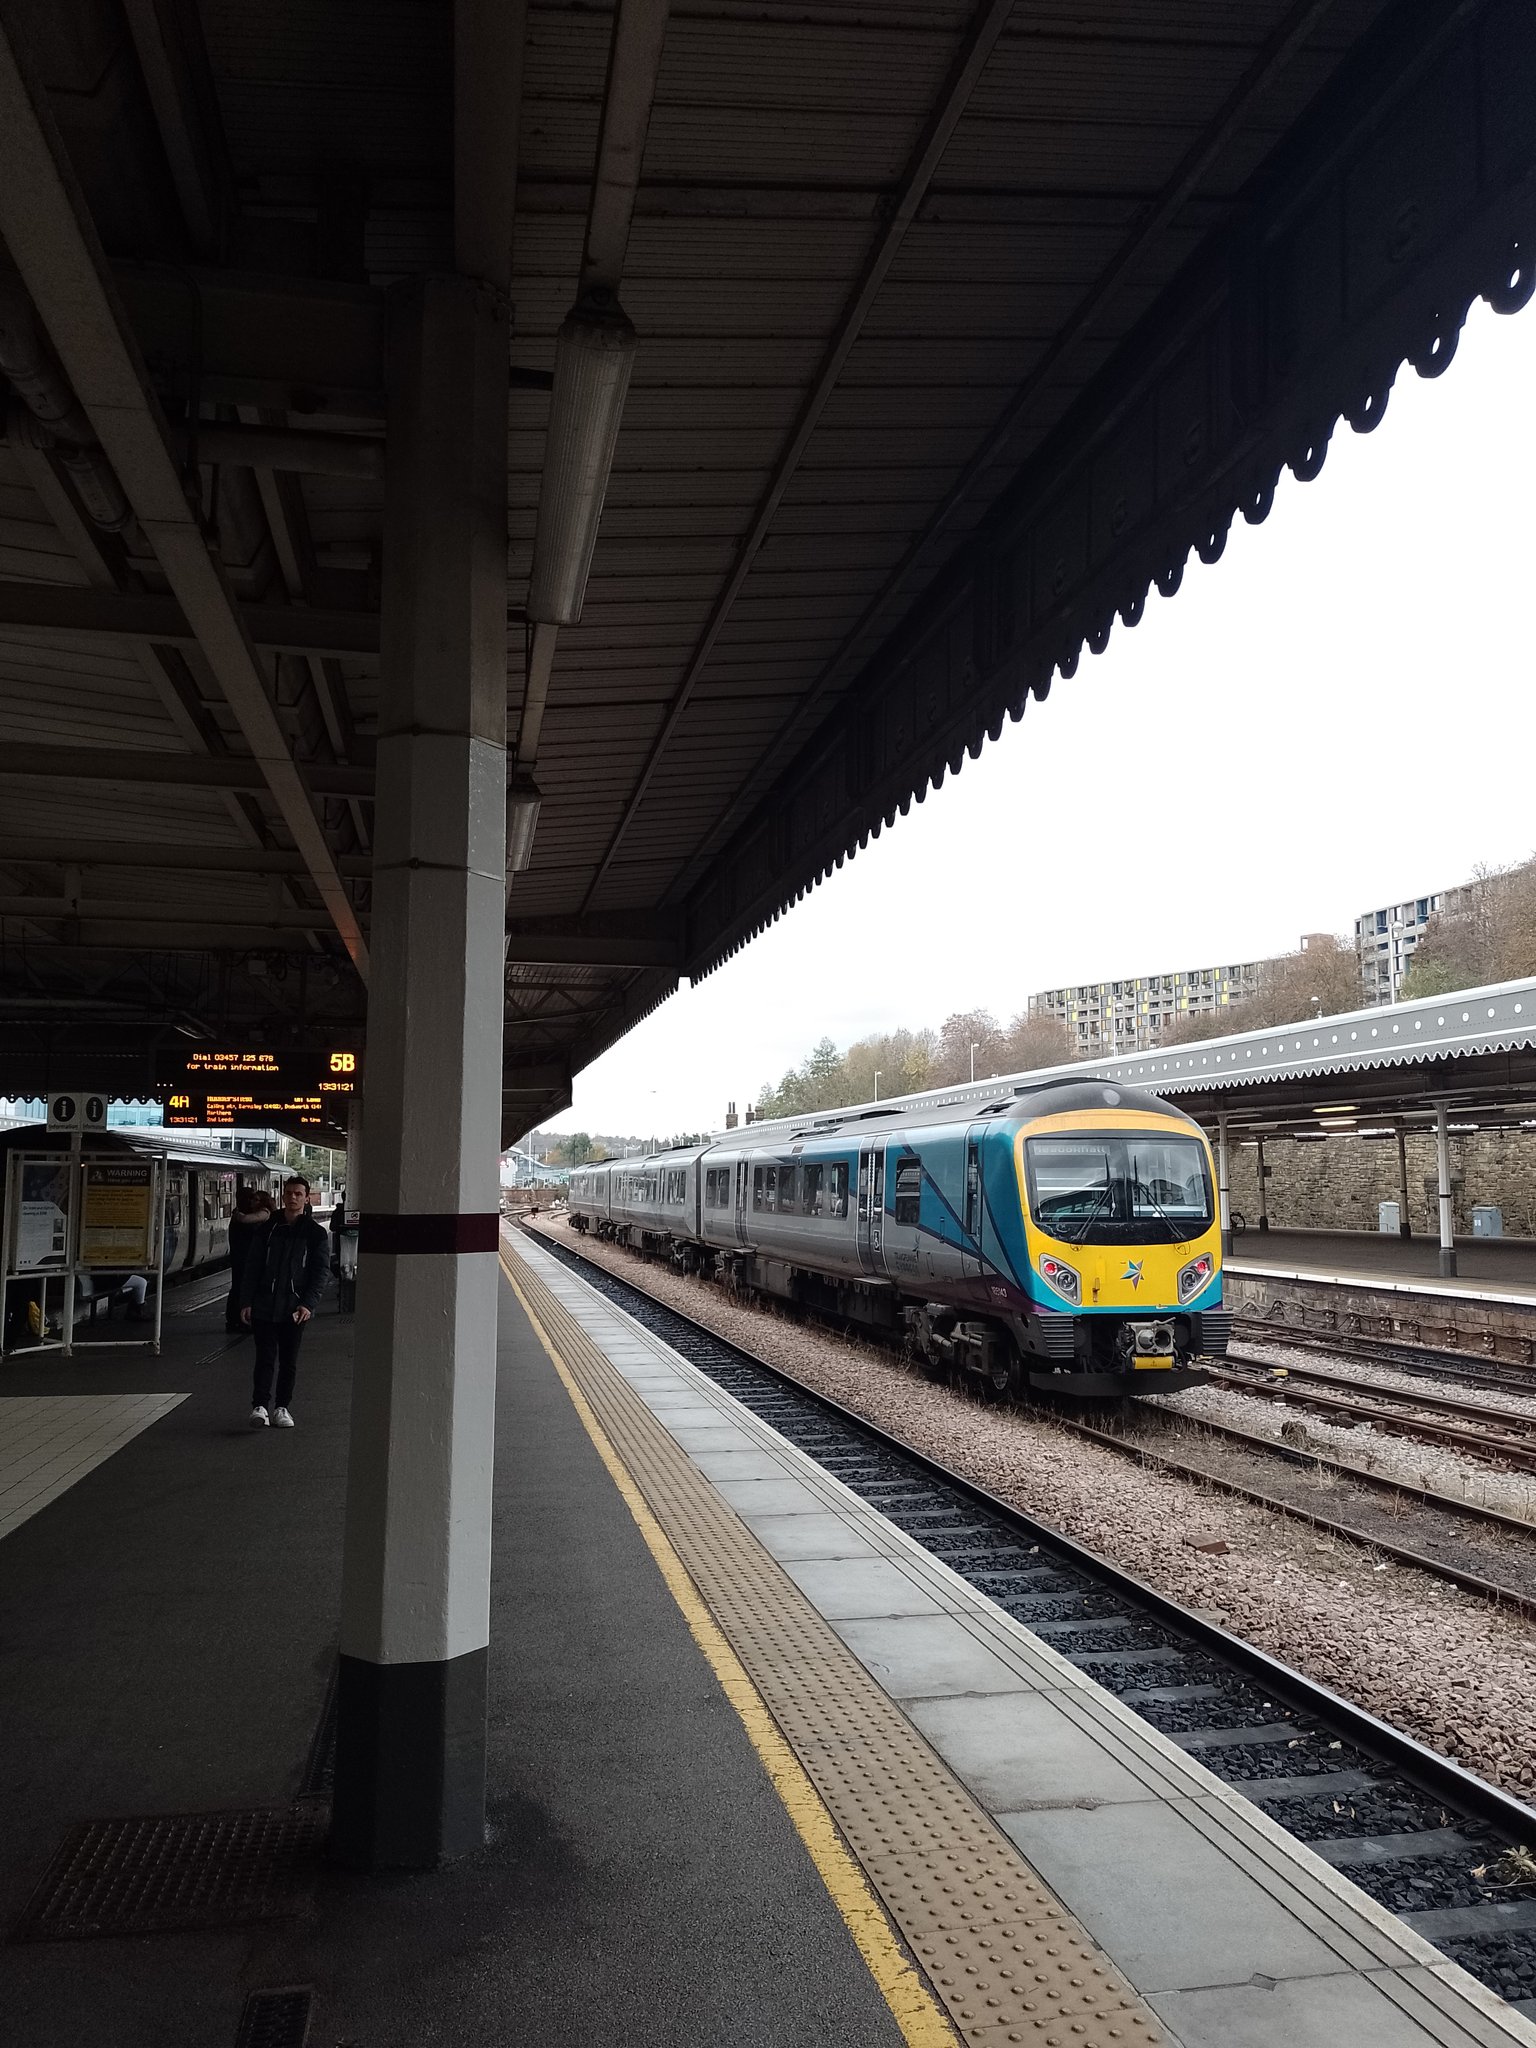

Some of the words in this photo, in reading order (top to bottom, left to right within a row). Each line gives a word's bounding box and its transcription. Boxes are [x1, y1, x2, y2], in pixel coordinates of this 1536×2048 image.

[192, 1053, 211, 1062] Dial
[214, 1054, 239, 1062] 03457
[242, 1054, 256, 1062] 125
[259, 1055, 274, 1063] 678
[329, 1053, 356, 1072] 5B
[186, 1062, 201, 1070] for
[204, 1063, 227, 1071] train
[230, 1063, 280, 1072] information
[318, 1082, 354, 1092] 13:31:21
[107, 1169, 148, 1178] WARNING
